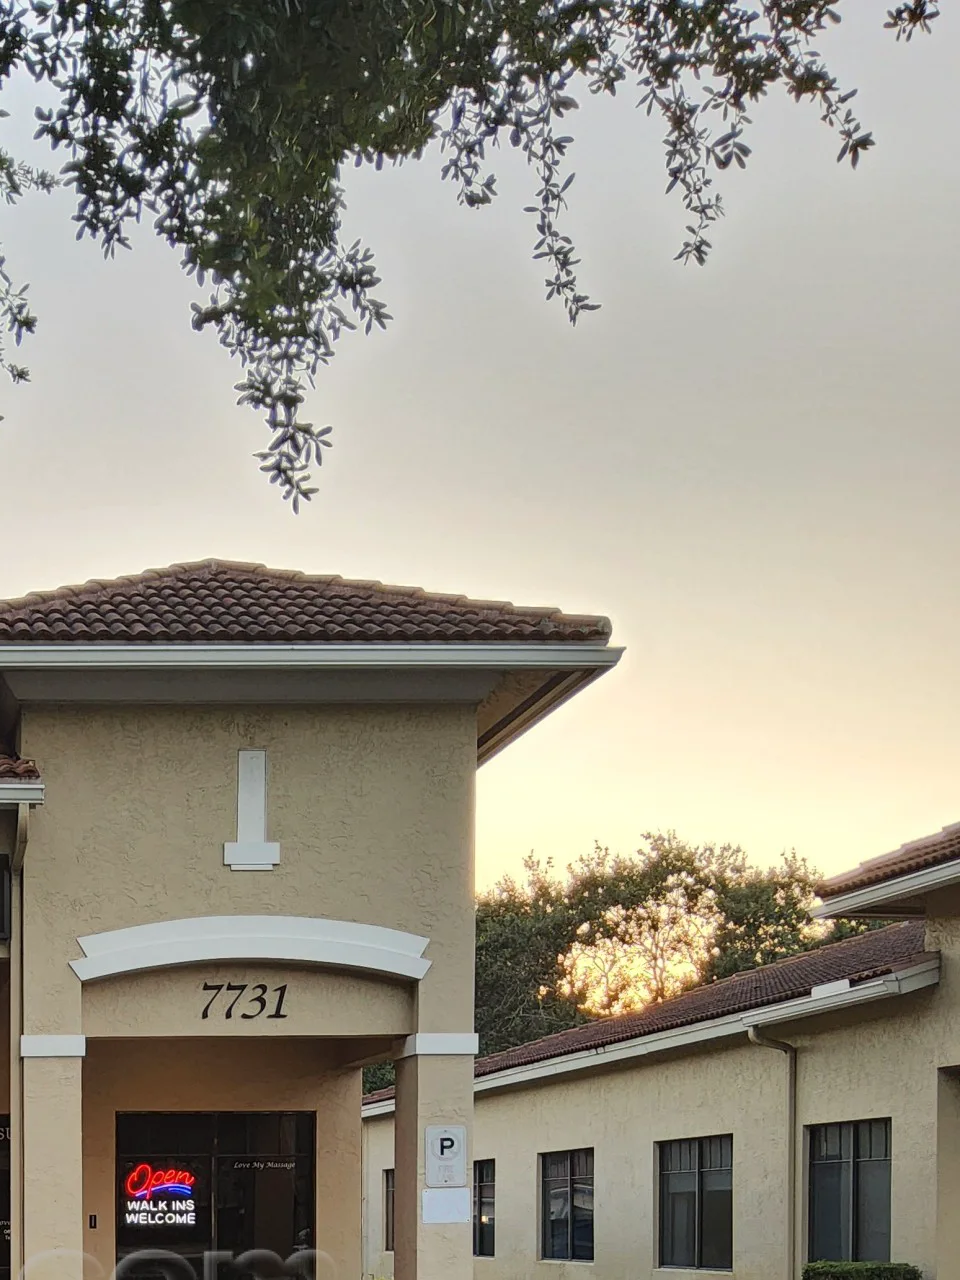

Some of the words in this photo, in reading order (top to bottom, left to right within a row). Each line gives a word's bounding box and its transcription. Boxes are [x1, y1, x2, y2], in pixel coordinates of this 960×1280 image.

[201, 981, 288, 1020] 7731
[439, 1137, 455, 1156] P
[233, 1161, 251, 1169] Love
[252, 1161, 265, 1170] My
[266, 1161, 296, 1170] Massage
[126, 1163, 195, 1200] Open
[127, 1200, 169, 1211] WALK
[171, 1200, 195, 1211] INS
[125, 1213, 196, 1224] WELCOME
